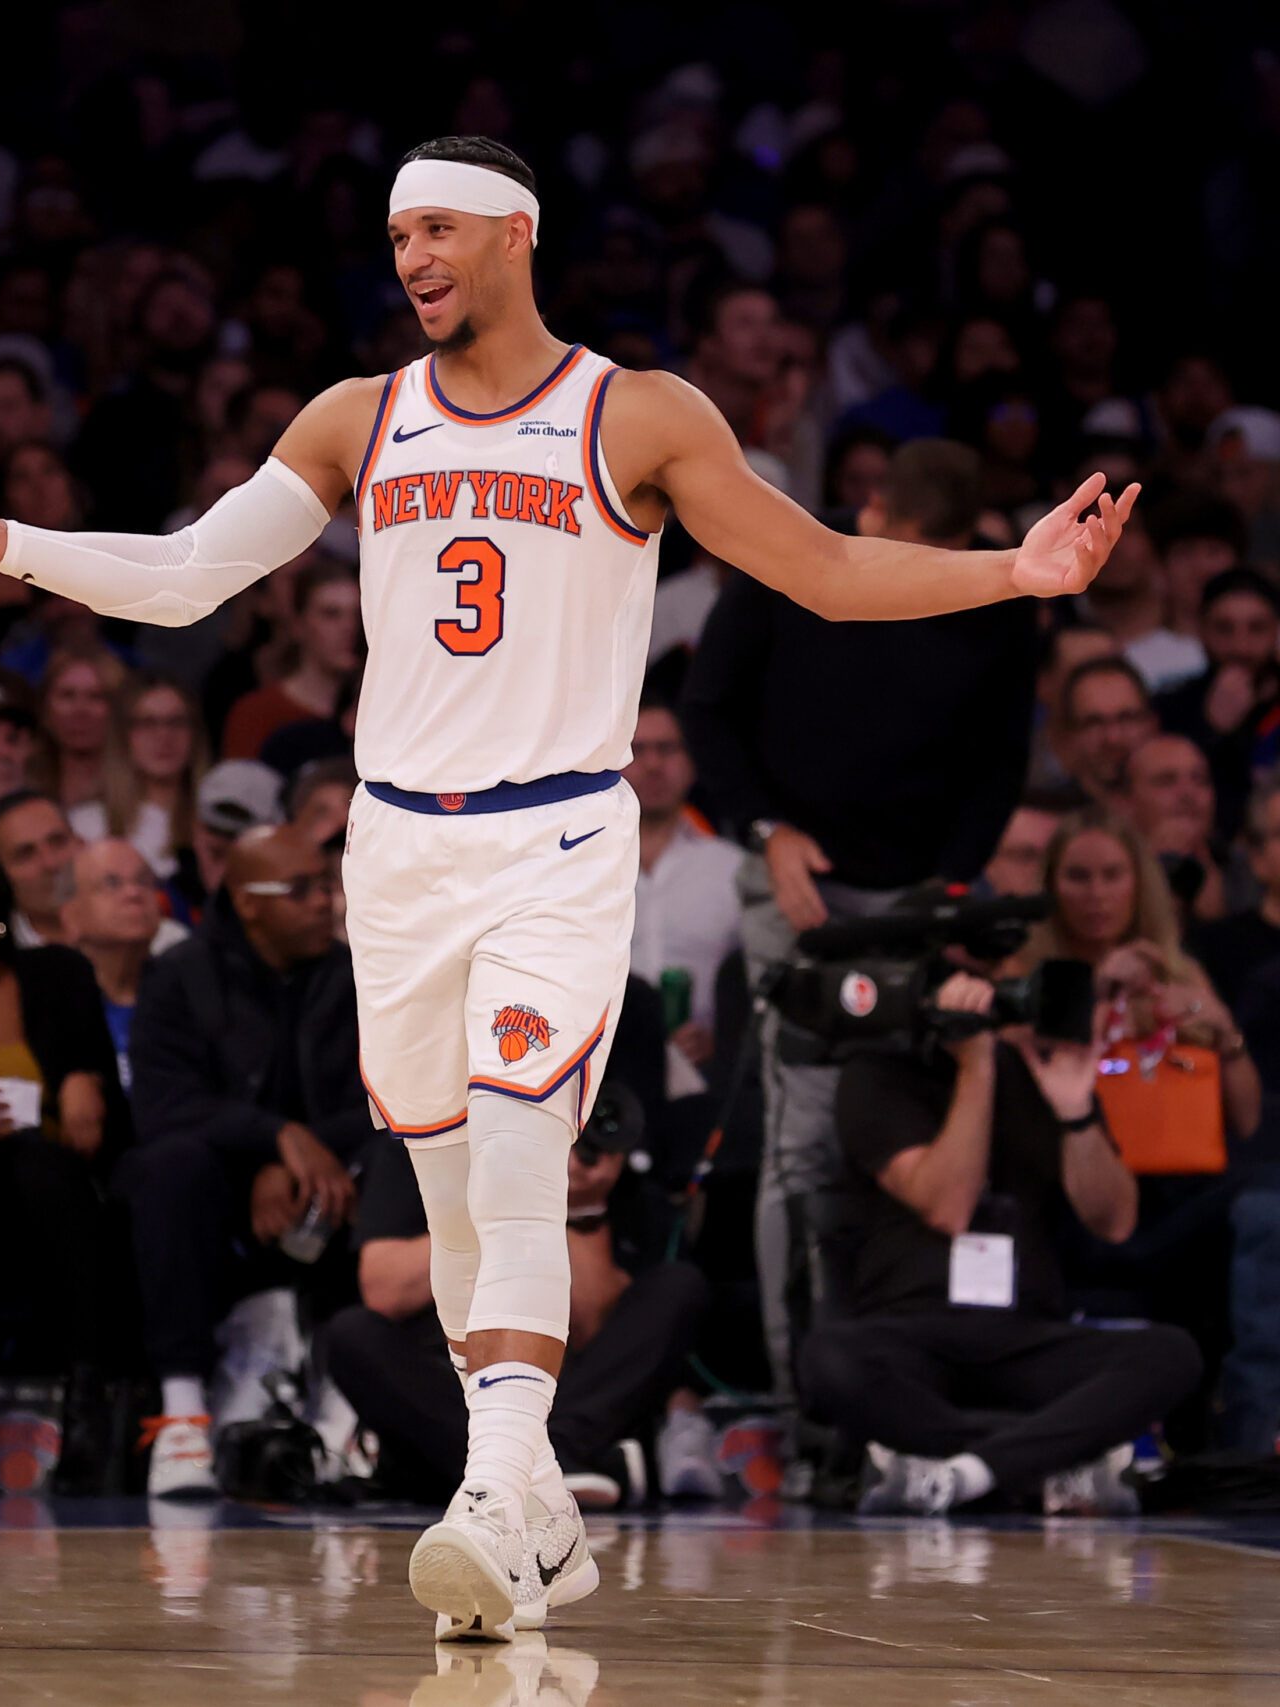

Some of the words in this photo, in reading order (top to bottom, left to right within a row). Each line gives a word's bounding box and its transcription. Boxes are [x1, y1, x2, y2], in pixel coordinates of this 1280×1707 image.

[517, 427, 540, 435] abu
[542, 427, 577, 437] dhabi
[372, 470, 464, 534] NEW
[467, 470, 584, 538] YORK
[435, 537, 505, 656] 3
[491, 1006, 550, 1048] KNICKS
